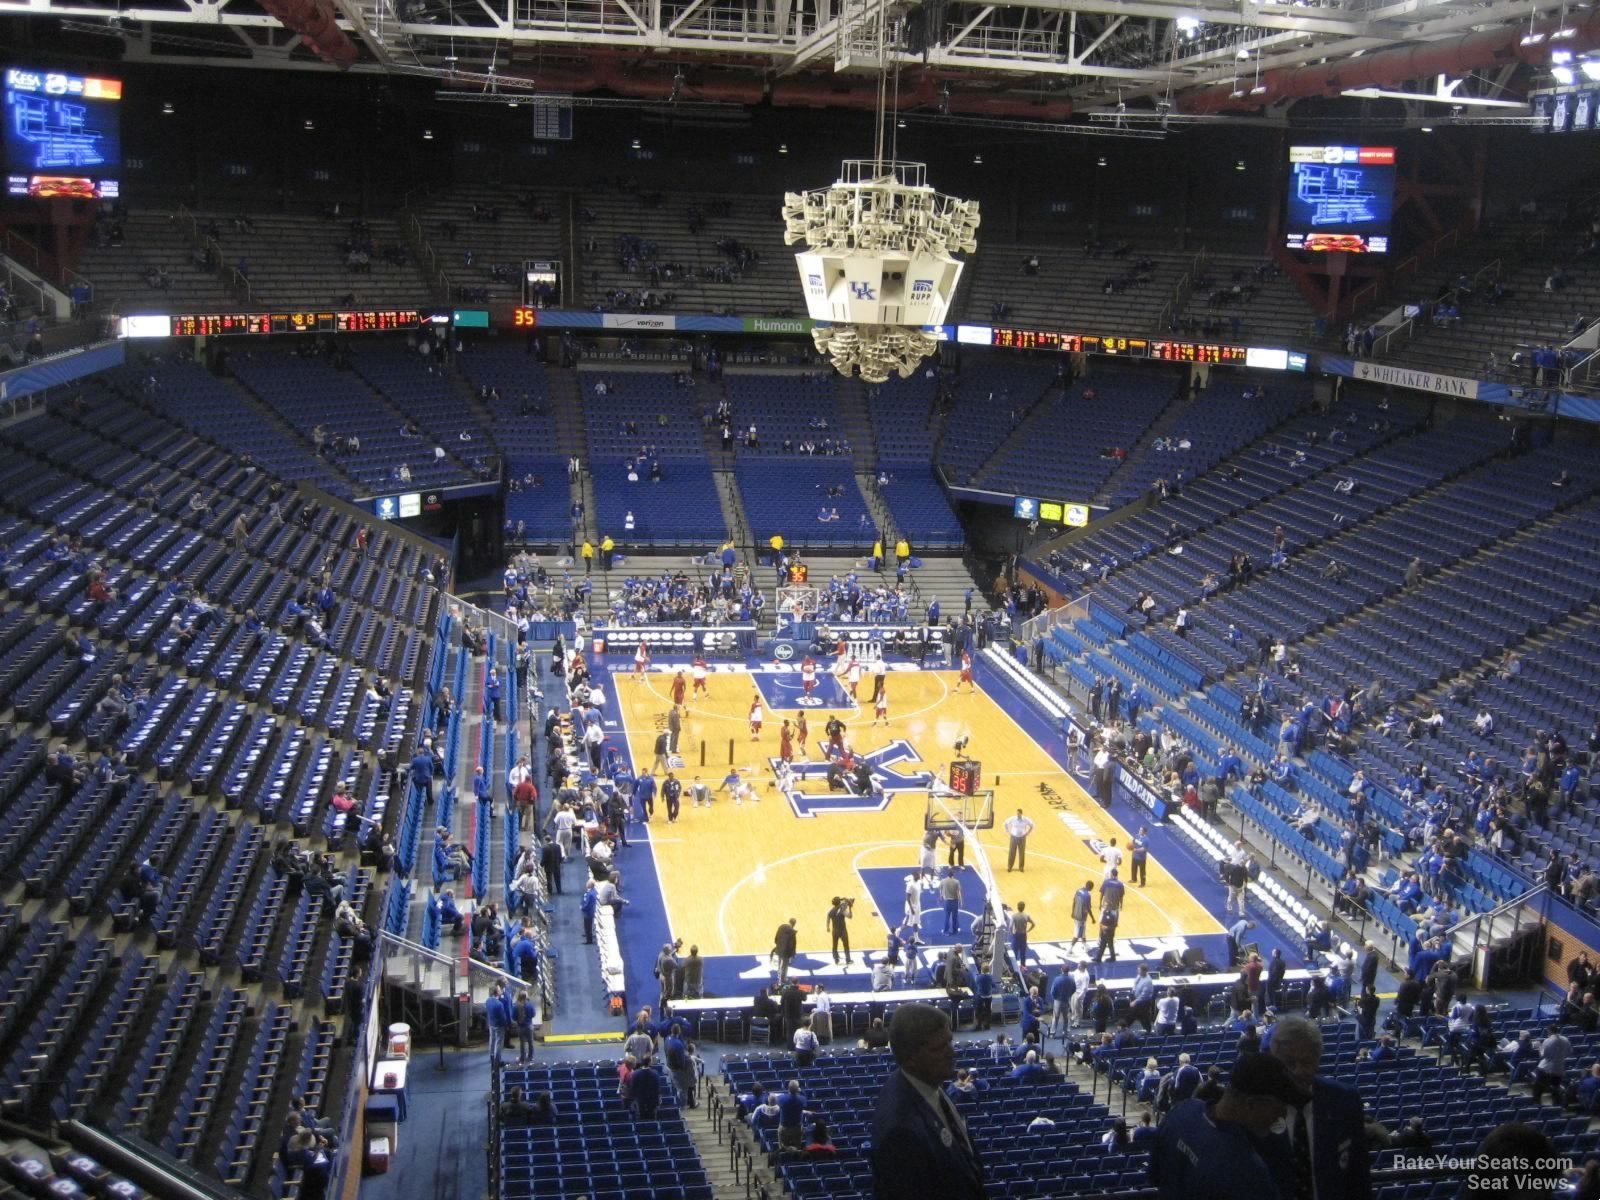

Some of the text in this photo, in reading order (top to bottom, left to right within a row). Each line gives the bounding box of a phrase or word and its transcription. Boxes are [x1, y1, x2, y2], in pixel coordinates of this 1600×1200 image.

[850, 281, 876, 300] UK
[515, 310, 534, 325] 35
[637, 319, 664, 327] verizon
[754, 319, 803, 331] Humana
[1374, 367, 1469, 395] WHITAKER BANK
[791, 572, 804, 582] 35
[952, 775, 966, 792] 35
[1120, 766, 1157, 809] WILDCATS
